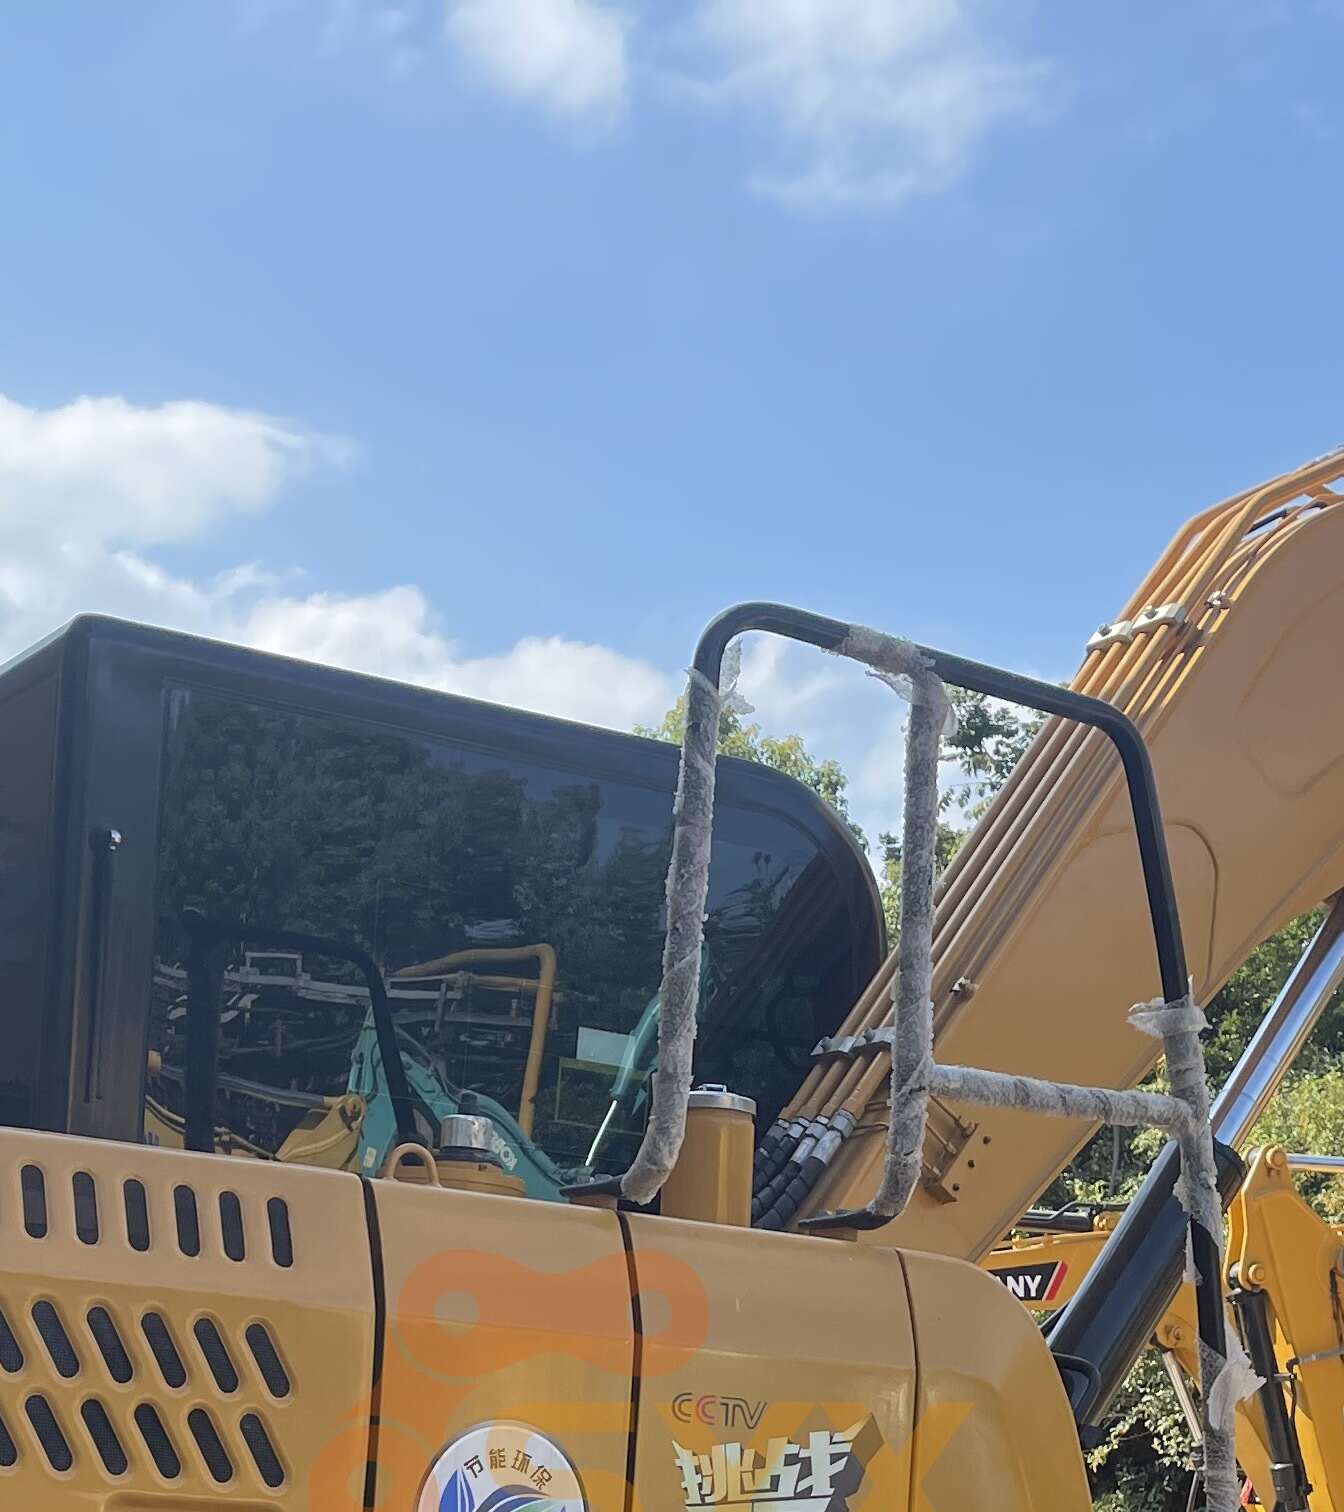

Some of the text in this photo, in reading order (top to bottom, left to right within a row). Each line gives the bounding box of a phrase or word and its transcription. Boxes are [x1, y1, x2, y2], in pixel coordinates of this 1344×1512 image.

[996, 1275, 1042, 1298] NY
[671, 1392, 767, 1430] CCTV
[463, 1447, 553, 1491] 节能环保
